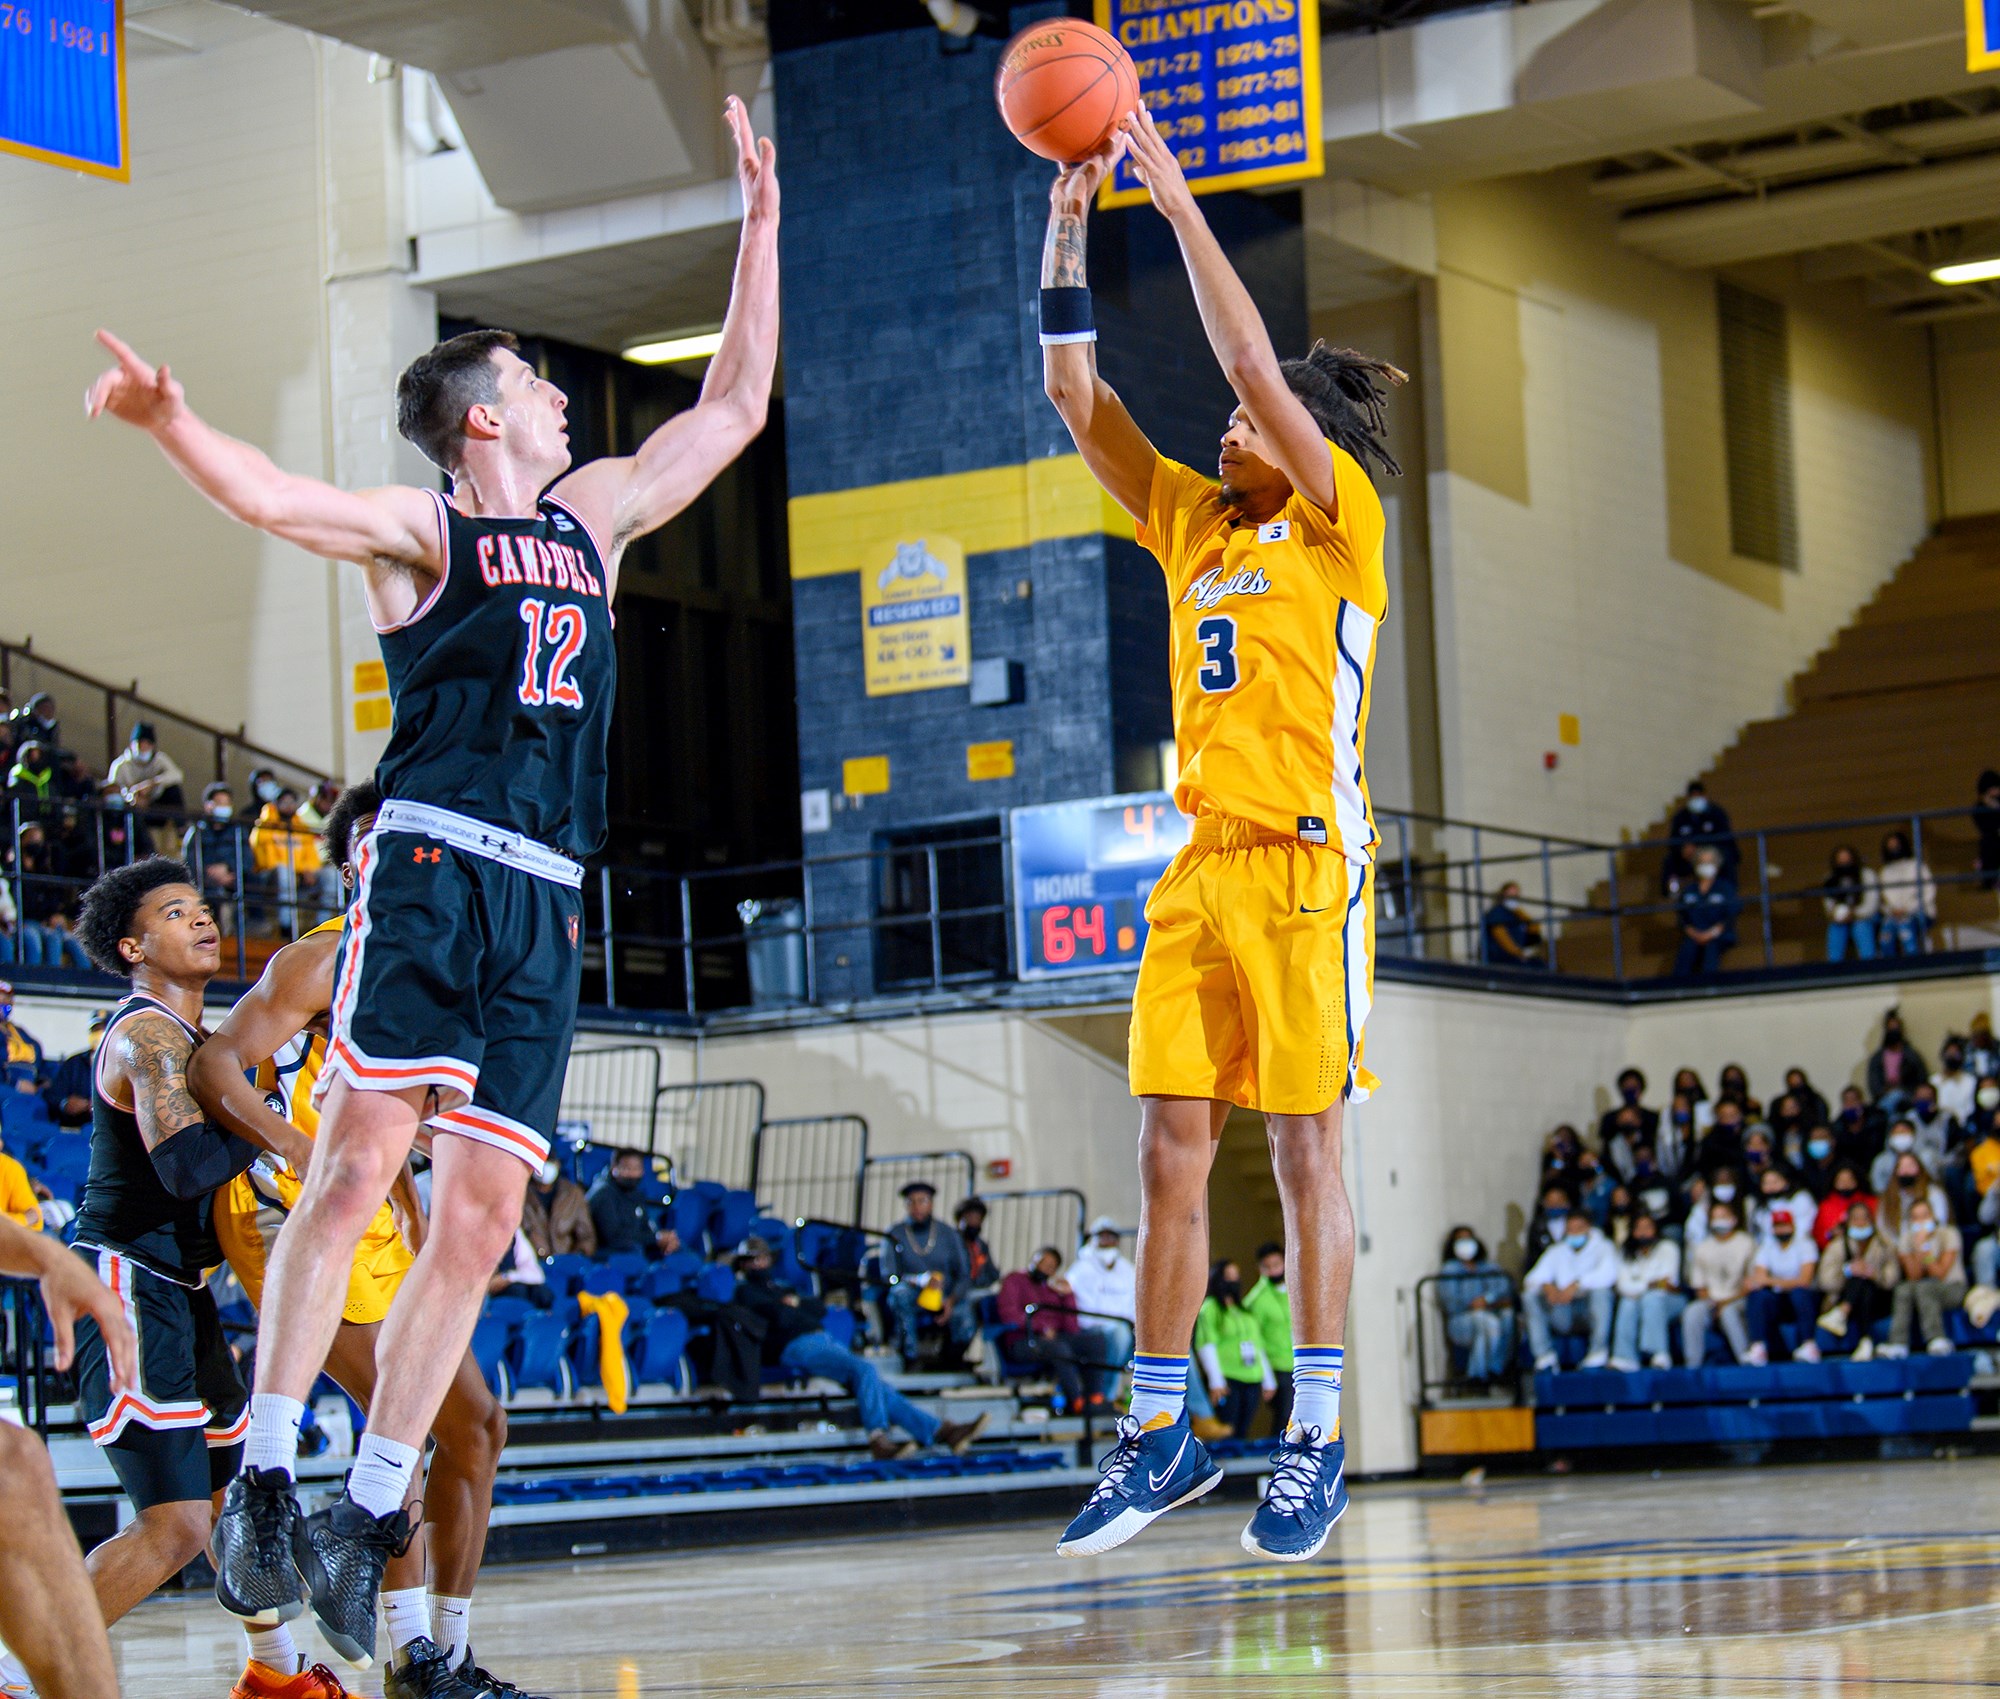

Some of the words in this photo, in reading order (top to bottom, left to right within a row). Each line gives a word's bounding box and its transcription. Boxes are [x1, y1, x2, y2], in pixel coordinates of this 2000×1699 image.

[51, 18, 109, 56] 1981
[1119, 0, 1297, 48] CHAMPIONS
[1136, 51, 1202, 79] 971-72
[1140, 82, 1205, 110] 75-76
[1217, 66, 1300, 100] 1977-78
[1216, 99, 1299, 132] 1980-81
[476, 534, 602, 597] CAMPBELL
[1182, 564, 1271, 610] Aggies
[872, 598, 956, 625] RESERVED
[518, 597, 588, 710] 12
[1195, 614, 1241, 694] 3
[395, 812, 438, 828] ARMOUR
[442, 823, 477, 840] UNDER
[1307, 818, 1317, 829] L
[1033, 872, 1095, 905] HOME
[1042, 904, 1106, 963] 64
